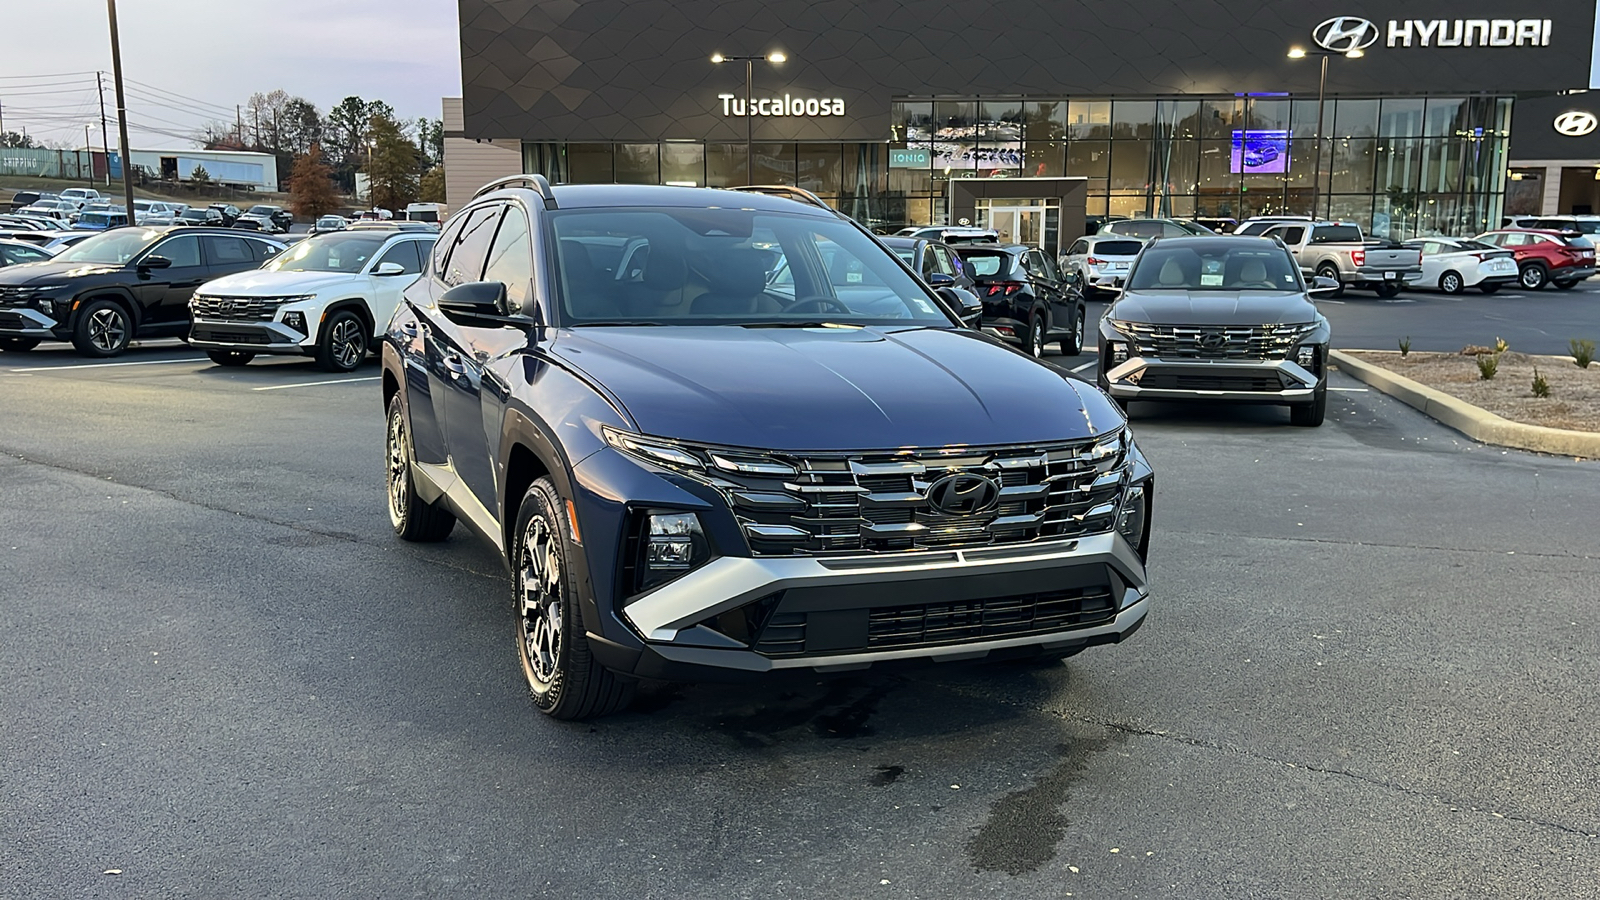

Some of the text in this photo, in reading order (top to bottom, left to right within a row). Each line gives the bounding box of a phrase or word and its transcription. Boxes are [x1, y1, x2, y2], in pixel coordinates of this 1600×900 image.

[1387, 19, 1552, 47] HYUNDAI
[718, 93, 845, 116] Tuscaloosa
[3, 157, 37, 168] SHIPPING
[893, 154, 925, 163] IONIQ
